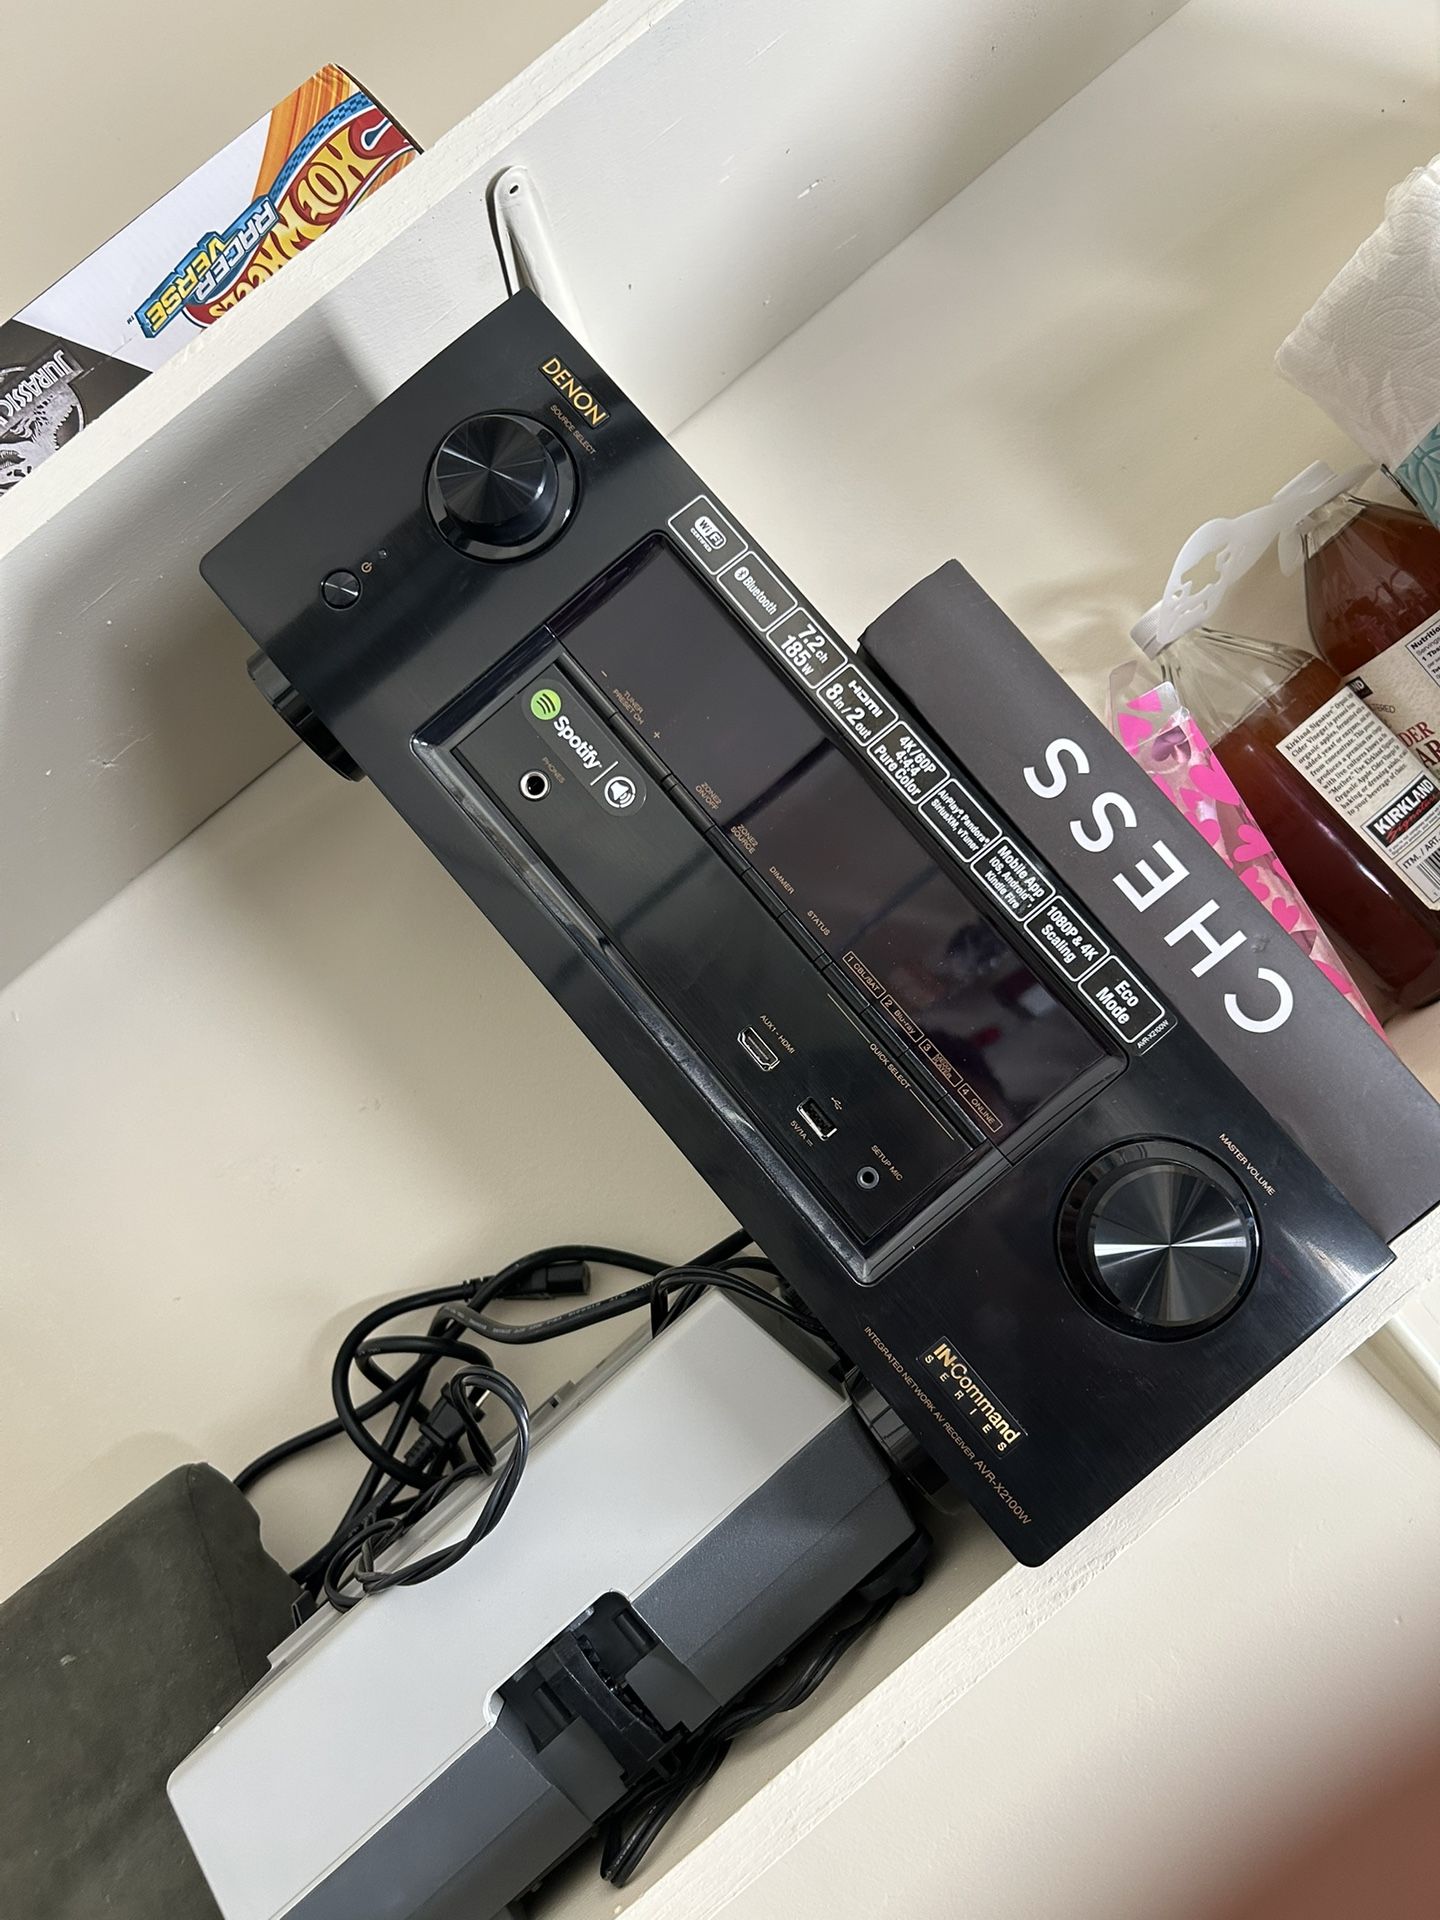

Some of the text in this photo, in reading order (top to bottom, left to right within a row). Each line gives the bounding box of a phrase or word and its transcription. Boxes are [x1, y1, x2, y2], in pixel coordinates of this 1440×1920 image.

[297, 127, 387, 220] HOT
[196, 201, 277, 298] RACER
[145, 236, 227, 331] VERSE
[0, 350, 74, 417] JURASSIC
[542, 358, 606, 425] DENON
[550, 404, 596, 454] SOURCE SELECT
[742, 575, 777, 615] Bluetooth
[1410, 625, 1440, 650] Nutritio
[613, 688, 644, 725] PRESET CH
[620, 690, 643, 716] TUNER
[848, 680, 883, 718] HDMI
[553, 715, 601, 769] Spotify
[899, 736, 936, 772] 4K/60P
[1285, 727, 1311, 751] Kirkland
[1291, 741, 1308, 757] Cider
[1306, 724, 1328, 744] Vinegar
[1298, 744, 1320, 764] organic
[1319, 728, 1338, 746] apples,
[1303, 753, 1322, 770] added
[1320, 741, 1336, 756] yeast
[542, 756, 565, 783] PHONES
[874, 744, 921, 796] Pure Color
[895, 747, 922, 777] 4:4:4
[1309, 762, 1325, 777] from
[1316, 759, 1343, 784] produces
[1345, 739, 1367, 759] premium
[1321, 776, 1336, 789] with
[1334, 766, 1347, 778] live
[1345, 750, 1367, 769] cultures
[1353, 762, 1365, 774] Use
[1363, 747, 1383, 765] Kirkland
[695, 785, 719, 809] ON/OFF
[700, 782, 722, 804] ZONE2
[1334, 781, 1358, 803] Organic
[1356, 768, 1372, 784] Apple
[1370, 758, 1384, 771] Cider
[1340, 790, 1361, 809] baking
[1366, 766, 1388, 787] dressing
[1347, 807, 1356, 816] to
[1353, 796, 1368, 810] your
[1366, 777, 1390, 799] beverage
[931, 798, 979, 851] SiriusXM, vTuner
[1374, 778, 1434, 836] KIRKLAND
[730, 826, 755, 854] SOURCE
[736, 824, 758, 849] ZONE2
[769, 866, 794, 894] DIMMER
[997, 845, 1045, 897] Mobile App
[1403, 853, 1422, 869] ITM.
[984, 870, 1020, 909] Kindle Fire
[1023, 738, 1293, 1033] CHESS
[807, 910, 830, 936] STATUS
[1047, 906, 1099, 961] 1080P & 4K
[1041, 924, 1076, 964] Scaling
[853, 963, 880, 991] CBL/SAT
[1114, 980, 1139, 1007] Eco
[890, 1009, 916, 1038] Blu-ray
[1095, 986, 1130, 1024] Mode
[760, 1015, 776, 1032] AUX1
[778, 1035, 795, 1054] HDMI
[870, 1043, 911, 1088] QUICK SELECT
[790, 1120, 807, 1139] 5V/1A
[970, 1097, 995, 1125] ONLINE
[871, 1145, 903, 1180] SETUP MIC
[1219, 1133, 1276, 1196] MASTER VOLUME
[864, 1326, 1032, 1524] INTEGRATED NETWORK AV RECEIVER AVR-X2100W
